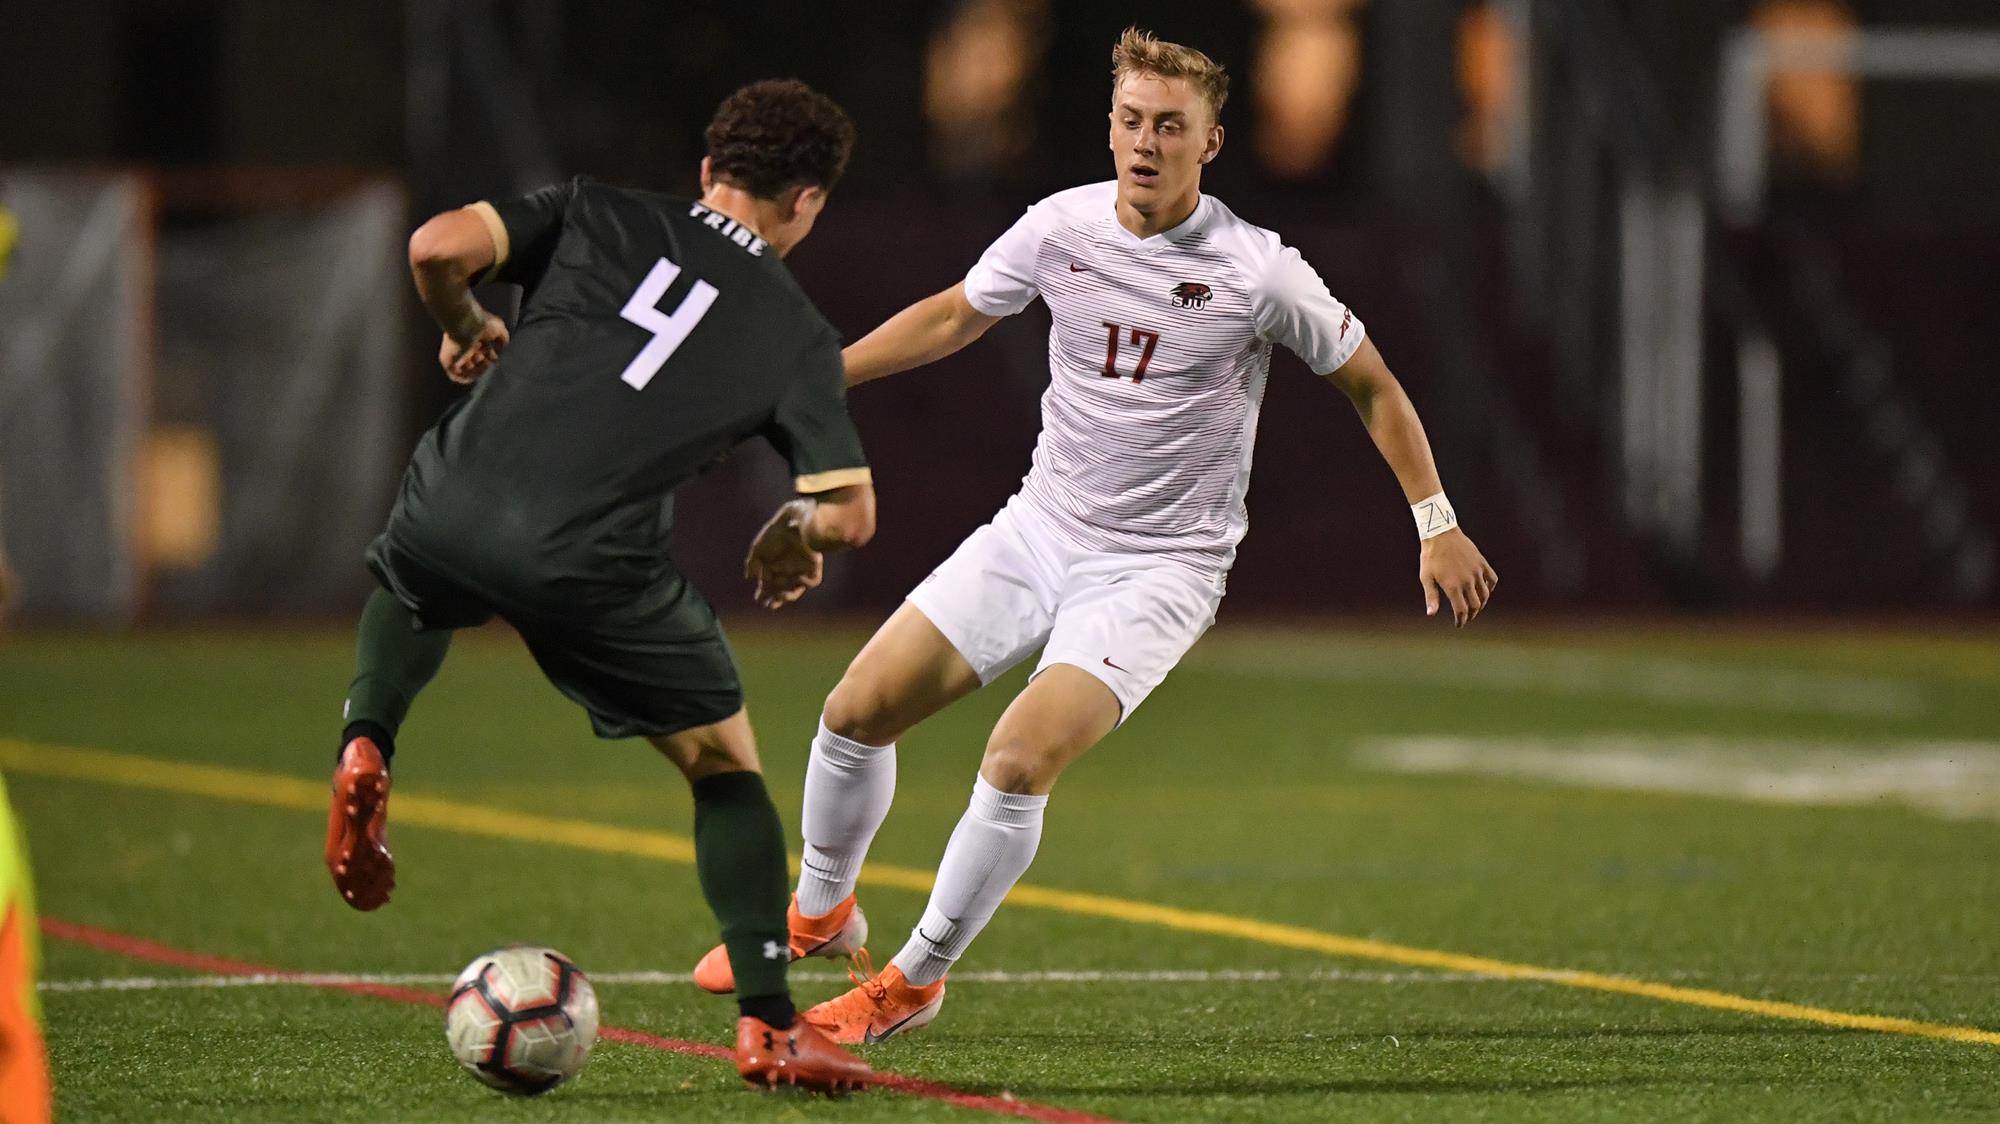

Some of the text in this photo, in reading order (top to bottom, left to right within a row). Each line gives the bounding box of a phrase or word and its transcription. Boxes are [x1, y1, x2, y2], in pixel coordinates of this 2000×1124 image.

[689, 203, 768, 256] TRIBE
[620, 256, 720, 391] 4
[1172, 296, 1206, 311] SJU
[1102, 320, 1160, 384] 17
